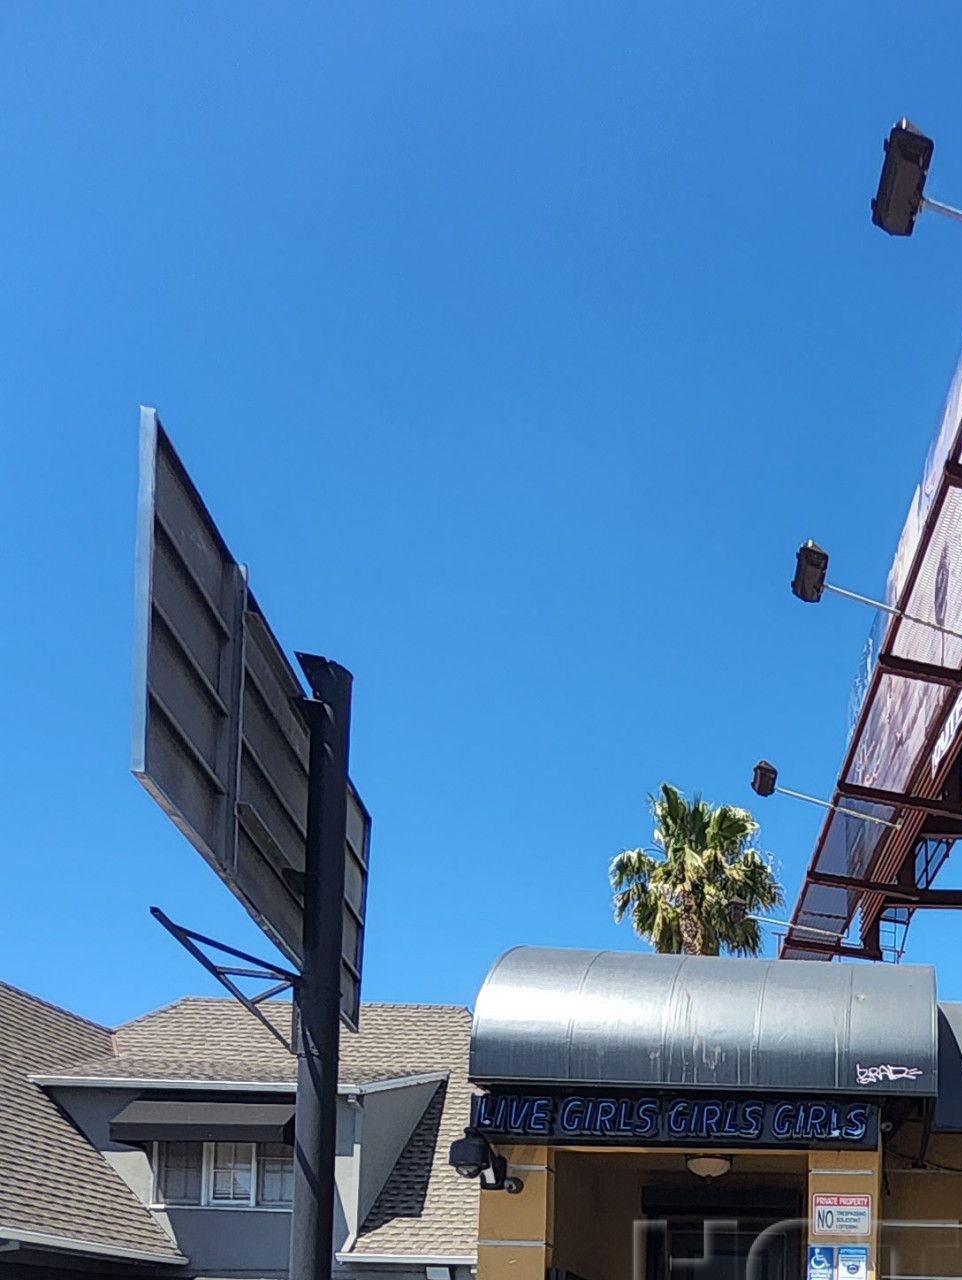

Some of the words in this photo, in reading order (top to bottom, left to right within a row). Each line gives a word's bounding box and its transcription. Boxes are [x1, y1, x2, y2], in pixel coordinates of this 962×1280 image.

[476, 1096, 552, 1134] LIVE
[561, 1098, 659, 1137] GIRLS
[667, 1100, 763, 1138] GIRLS
[772, 1103, 868, 1140] GIRLS
[817, 1210, 834, 1229] NO
